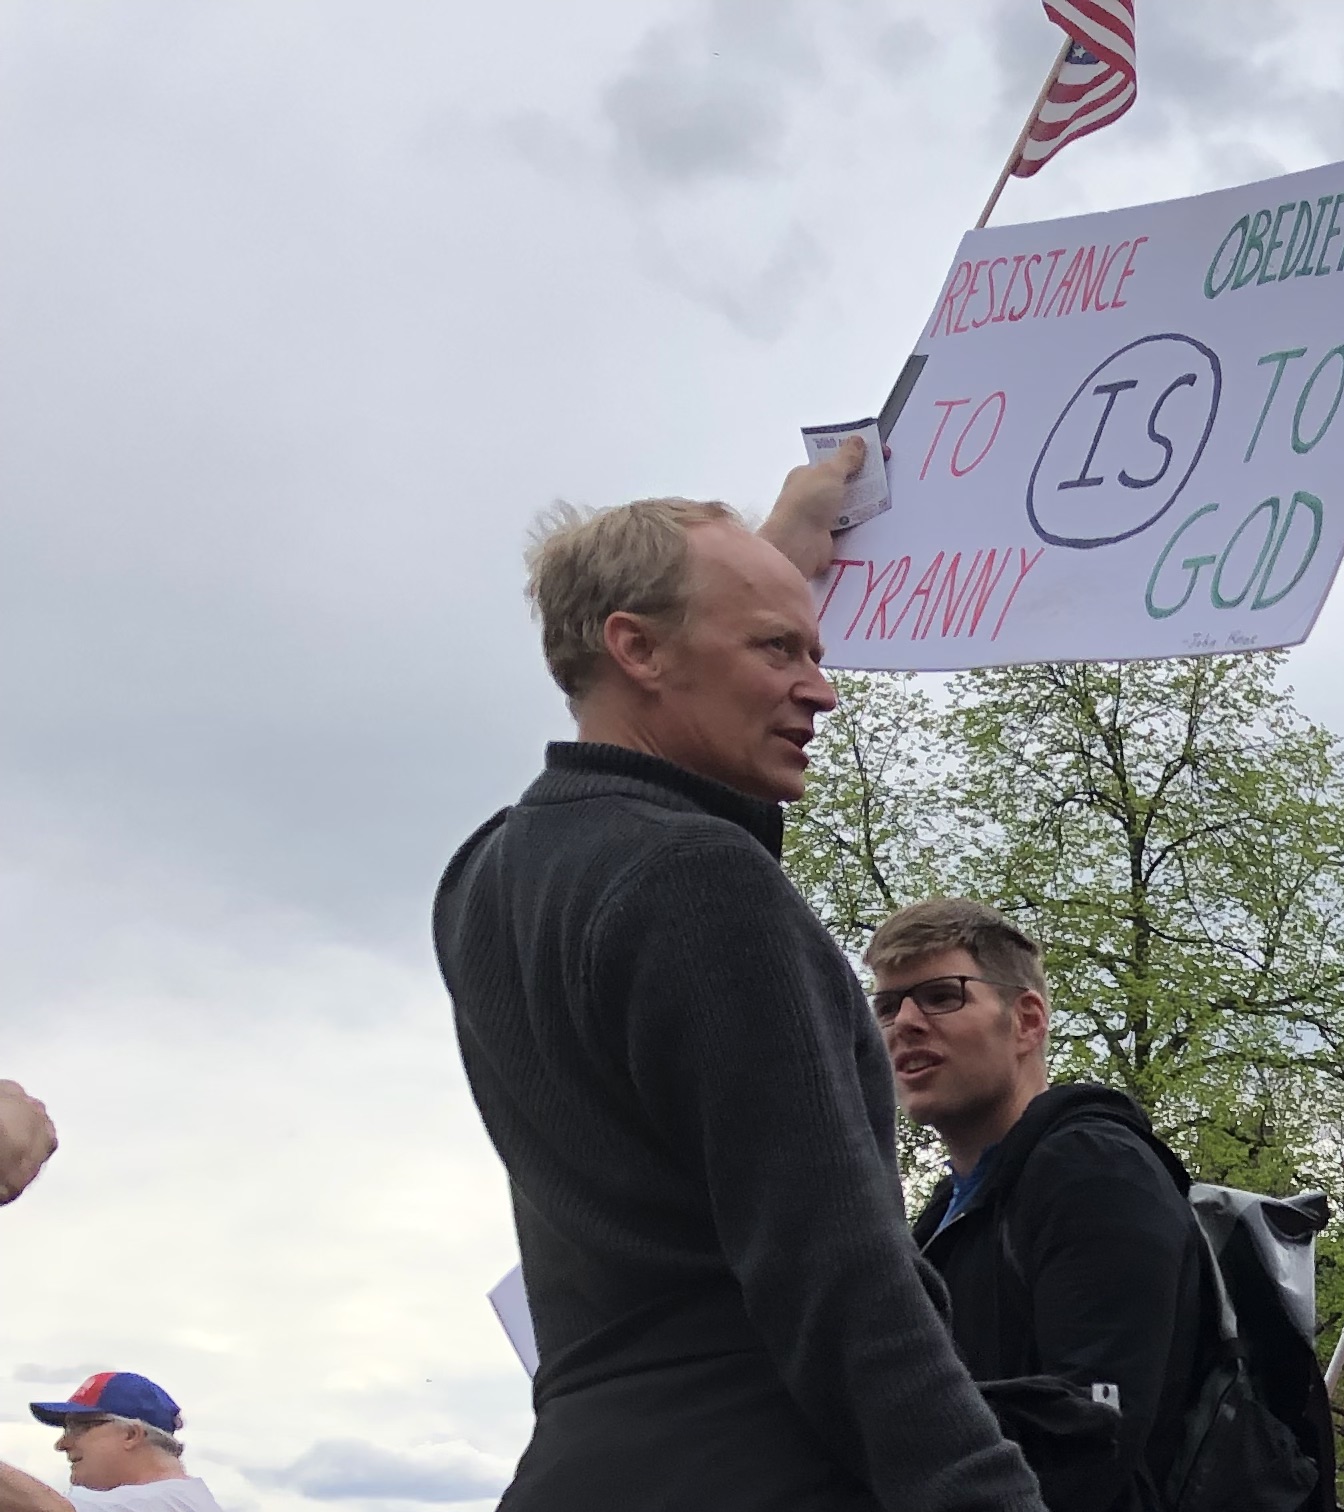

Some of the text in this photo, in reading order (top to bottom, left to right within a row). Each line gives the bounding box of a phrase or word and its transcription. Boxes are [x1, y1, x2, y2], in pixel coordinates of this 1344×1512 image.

[929, 236, 1149, 338] RESISTANCE
[918, 390, 1006, 480] TO
[1057, 372, 1198, 490] IS
[816, 546, 1046, 642] TYRANNY
[1144, 490, 1324, 620] GOD
